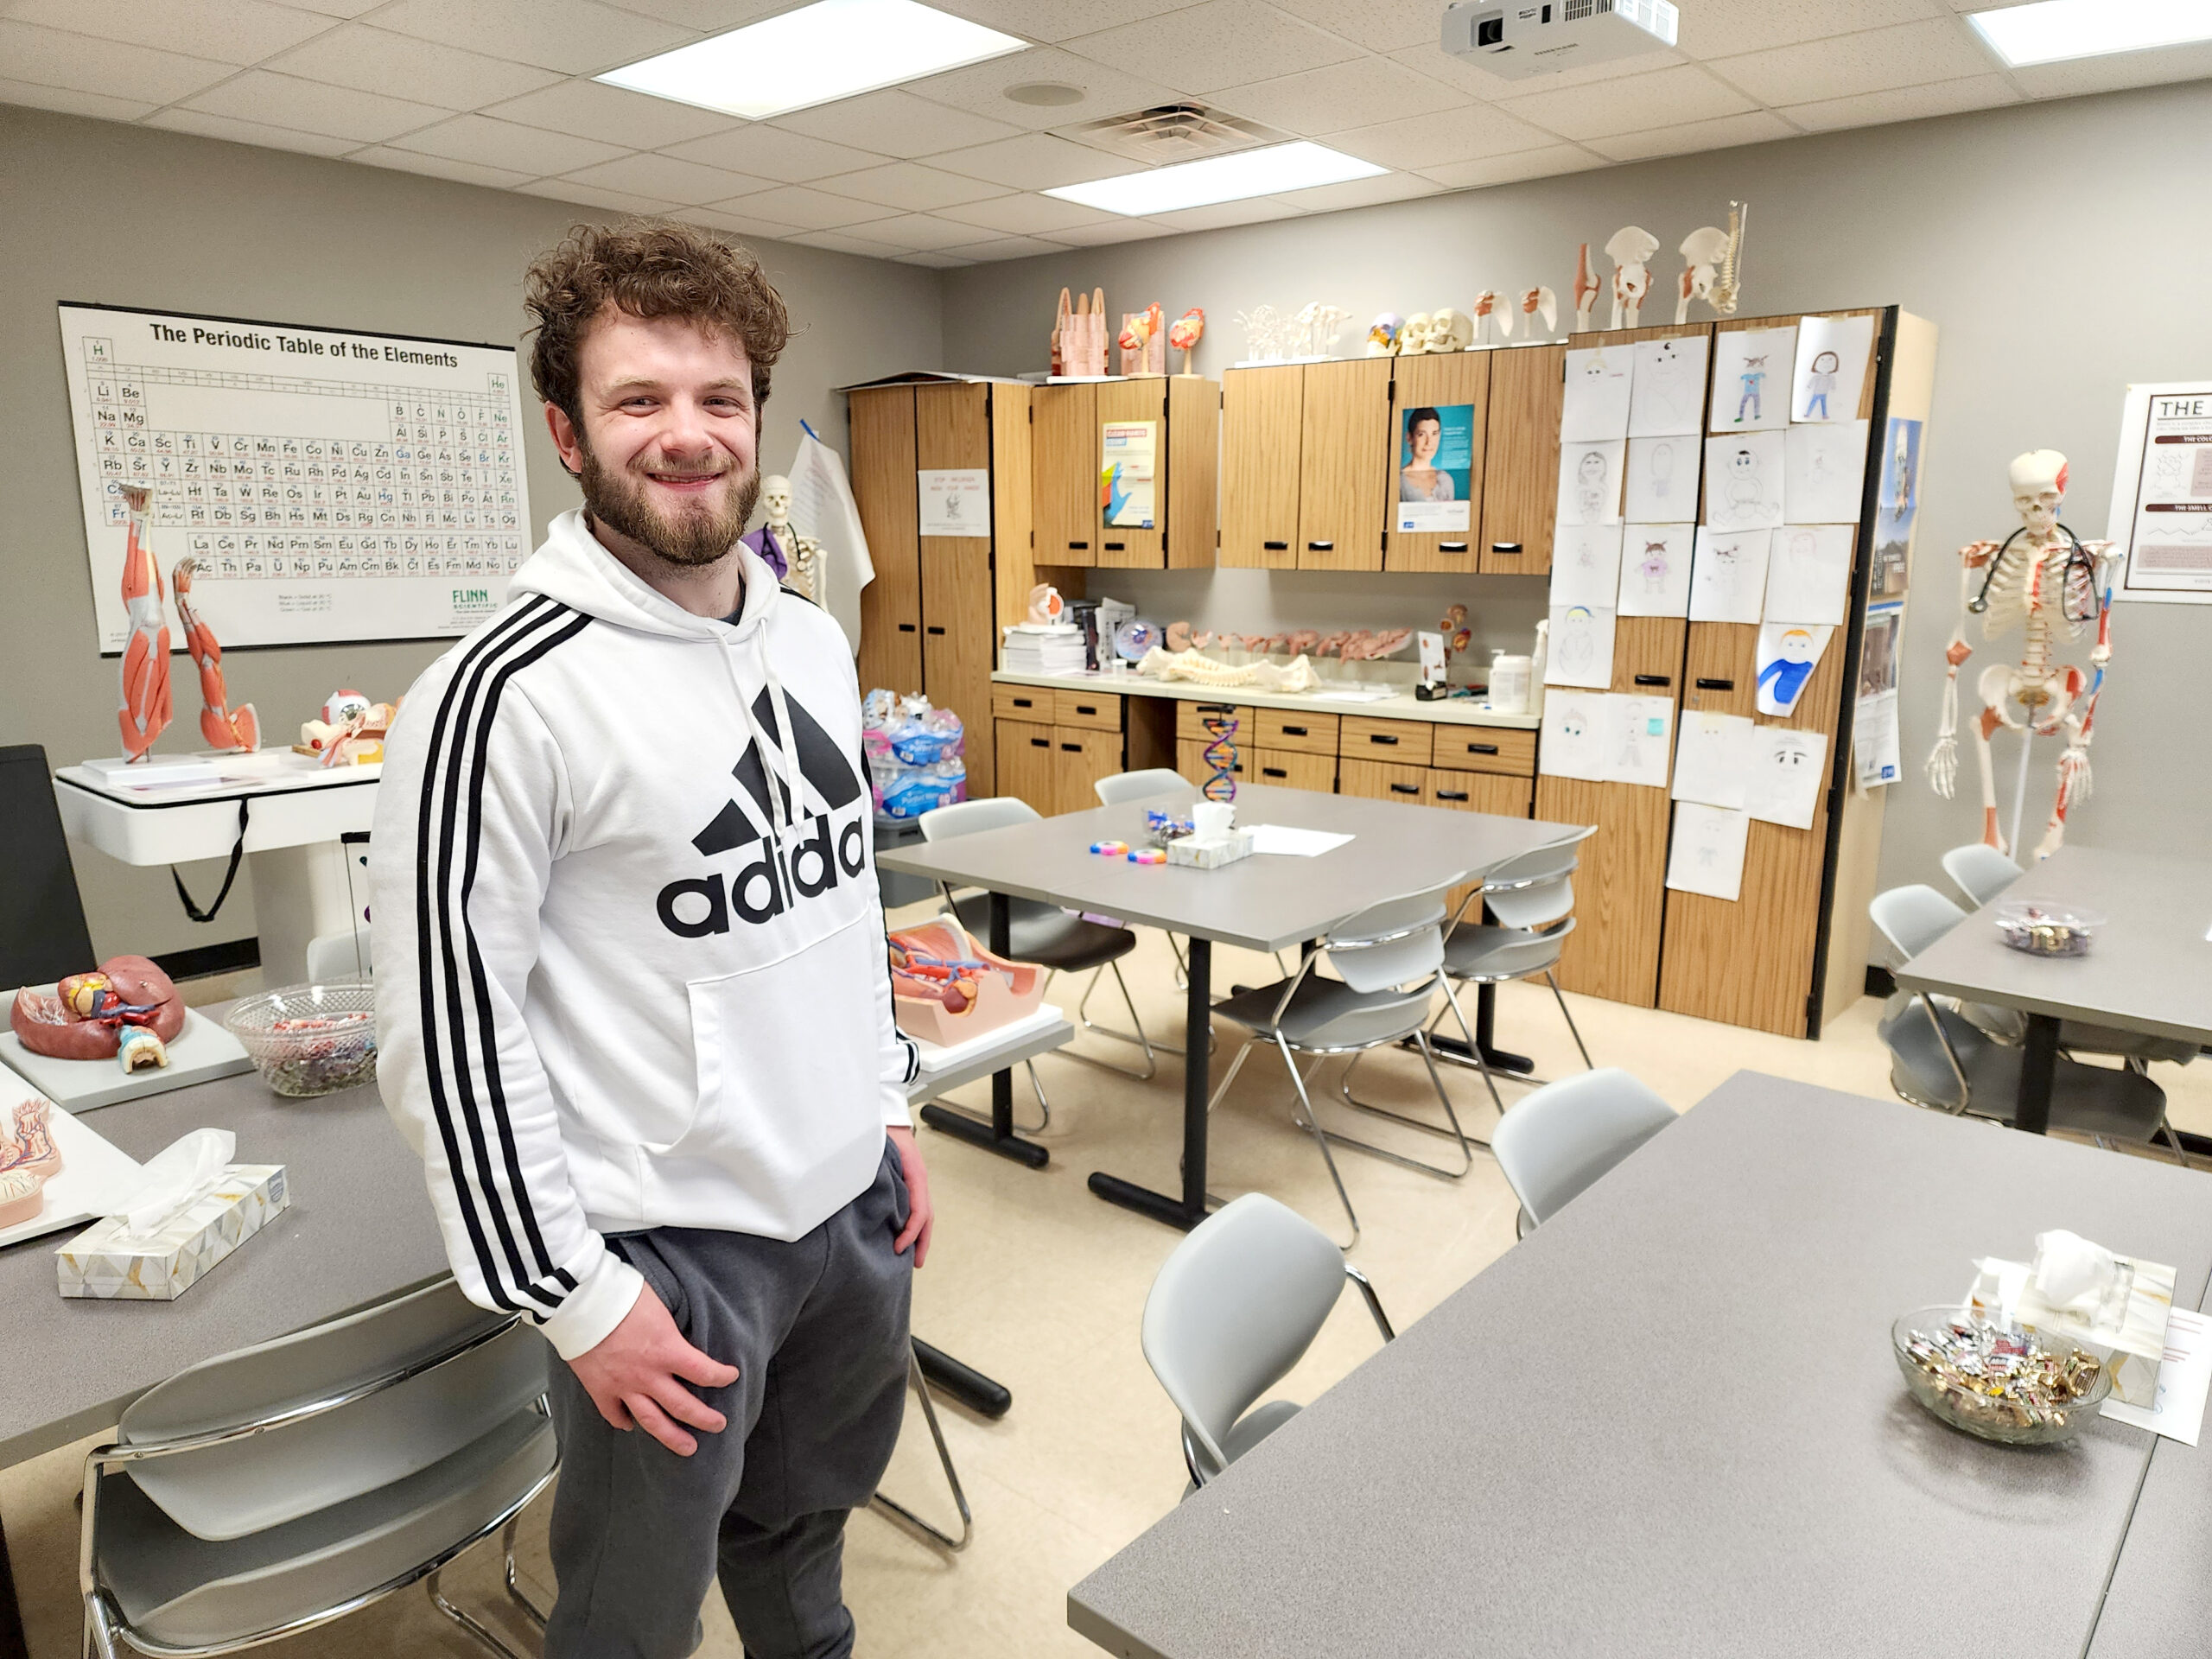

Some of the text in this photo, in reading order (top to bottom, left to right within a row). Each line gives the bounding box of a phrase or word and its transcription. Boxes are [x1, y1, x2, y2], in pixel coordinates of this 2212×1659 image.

[93, 346, 103, 355] H
[149, 324, 458, 367] The Periodic Table of the Elements
[98, 386, 109, 396] Li
[123, 388, 139, 397] Be
[417, 408, 424, 416] C
[438, 410, 445, 418] N
[2161, 400, 2203, 416] THE
[98, 411, 115, 421] Na
[124, 413, 143, 426] Mg
[397, 428, 406, 436] Al
[417, 429, 427, 438] Si
[461, 432, 467, 441] S
[479, 433, 487, 442] Cl
[105, 435, 114, 445] K
[128, 437, 145, 447] Ca
[156, 439, 171, 448] Sc
[183, 439, 195, 449] Ti
[212, 441, 219, 449] V
[235, 442, 248, 451] Cr
[257, 443, 276, 452] Mn
[283, 444, 297, 453] Fe
[353, 448, 366, 456] Cu
[374, 448, 389, 457] Zn
[417, 451, 431, 460] Ge
[460, 453, 471, 461] Se
[499, 454, 509, 463] Kr
[104, 461, 122, 470] Rb
[133, 461, 147, 470] Sr
[162, 462, 169, 471] Y
[186, 463, 199, 472] Zr
[210, 464, 226, 474] Nb
[234, 466, 253, 474] Mo
[262, 466, 275, 474] Tc
[308, 467, 323, 476] Rh
[332, 468, 346, 477] Pd
[355, 470, 368, 480] Ag
[376, 470, 391, 479] Cd
[401, 471, 410, 480] In
[420, 472, 433, 480] Sn
[441, 473, 453, 481] Sb
[461, 474, 472, 482] Te
[499, 474, 512, 483] Xe
[188, 487, 201, 496] Hf
[213, 487, 227, 497] Ta
[239, 488, 251, 497] W
[287, 489, 302, 498] Os
[378, 493, 392, 504] Hg
[403, 493, 411, 501] Tl
[422, 493, 435, 502] Pb
[443, 493, 453, 502] Bi
[461, 494, 474, 503] Po
[483, 494, 493, 503] At
[501, 495, 514, 504] Rn
[113, 509, 125, 518] Fr
[215, 511, 232, 519] Db
[240, 511, 256, 522] Sg
[289, 512, 304, 520] Hs
[359, 513, 372, 524] Rg
[380, 513, 395, 522] Cn
[426, 514, 434, 523] Fl
[443, 514, 457, 523] Mc
[502, 516, 515, 524] Og
[194, 540, 208, 550] La
[219, 540, 234, 549] Ce
[245, 540, 258, 549] Pr
[268, 540, 283, 549] Nd
[290, 540, 308, 549] Pm
[315, 540, 332, 549] Sm
[339, 540, 353, 549] Eu
[361, 541, 376, 550] Gd
[384, 541, 397, 550] Tb
[405, 541, 417, 551] Dy
[425, 541, 439, 550] Ho
[448, 541, 456, 550] Er
[464, 541, 480, 550] Tm
[485, 541, 498, 550] Yb
[274, 563, 282, 571] U
[294, 563, 309, 573] Np
[362, 562, 379, 570] Cm
[385, 562, 399, 570] Bk
[408, 562, 419, 570] Cf
[453, 589, 488, 602] FLINN
